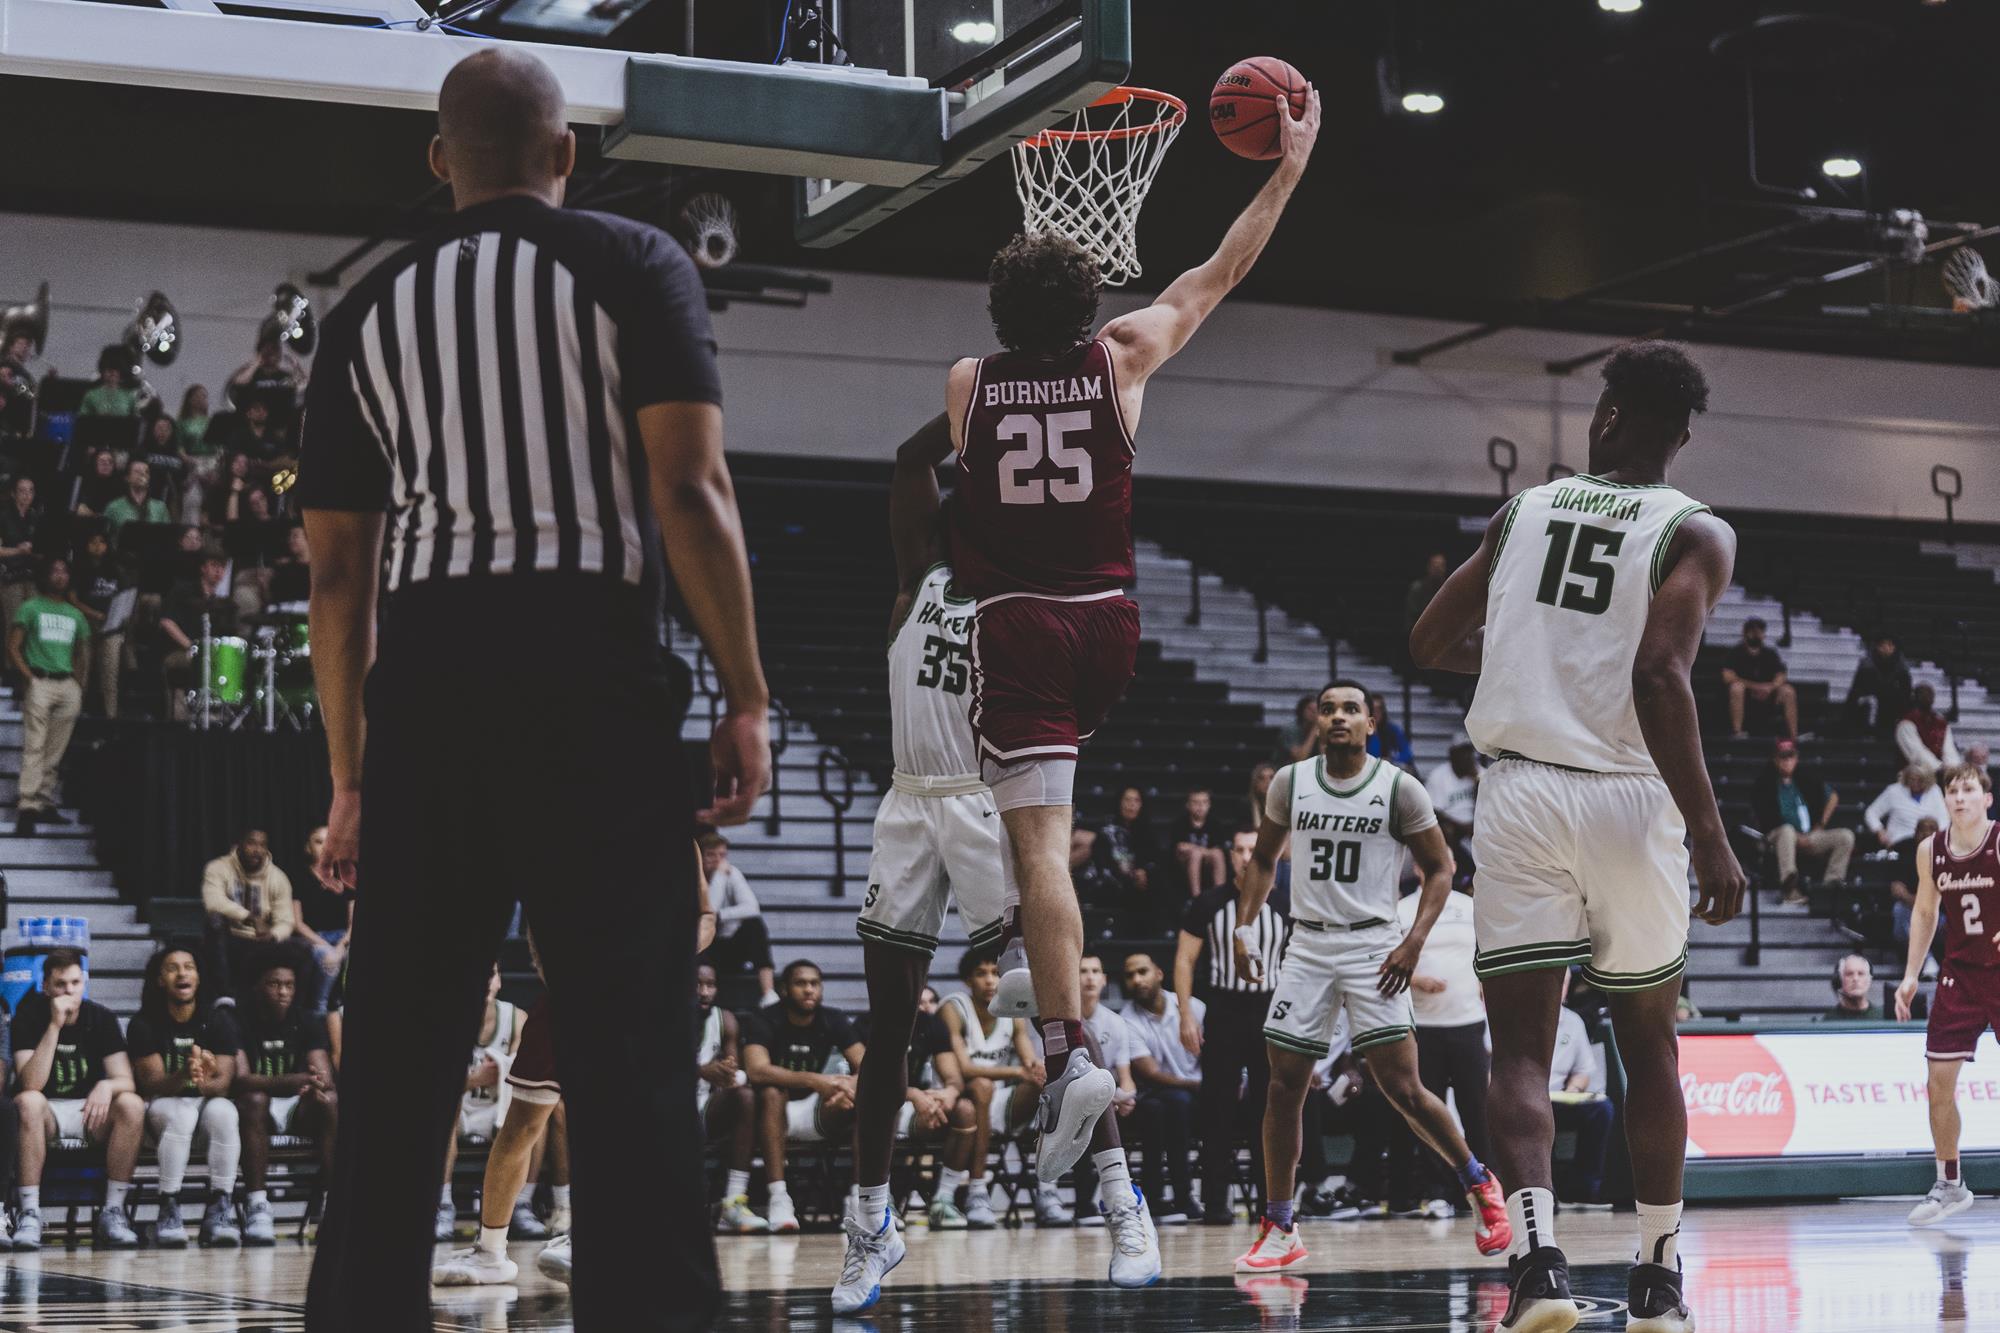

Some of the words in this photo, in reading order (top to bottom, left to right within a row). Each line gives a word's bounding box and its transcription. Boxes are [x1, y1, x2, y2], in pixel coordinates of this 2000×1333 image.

[984, 375, 1104, 407] BURNHAM
[996, 409, 1094, 505] 25
[1551, 487, 1643, 522] DIAWARA
[1536, 519, 1626, 615] 15
[917, 634, 970, 696] 35
[1297, 811, 1383, 834] HATTERS
[1310, 838, 1362, 883] 30
[1937, 872, 1995, 891] Charleston
[1960, 893, 1984, 935] 2
[1806, 1083, 1886, 1104] TASTE
[1893, 1081, 1929, 1102] TH
